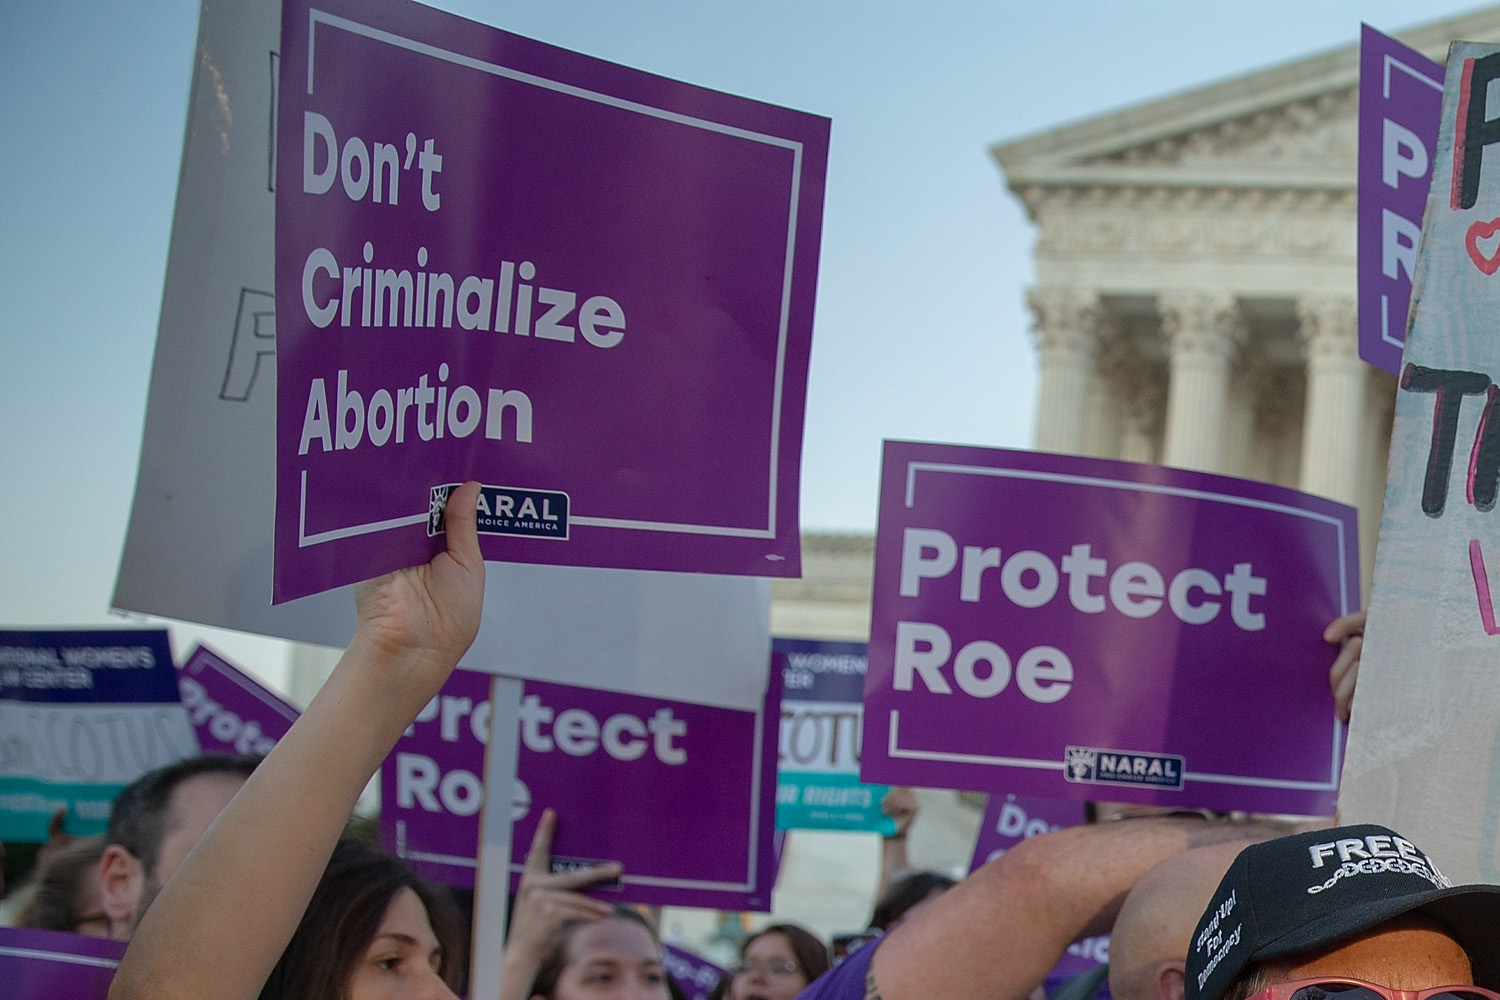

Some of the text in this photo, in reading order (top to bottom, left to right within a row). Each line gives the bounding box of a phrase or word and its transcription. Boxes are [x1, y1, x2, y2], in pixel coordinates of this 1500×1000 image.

[303, 111, 443, 212] Don’t
[302, 241, 627, 348] Criminalize
[298, 362, 533, 455] Abortion
[476, 493, 559, 521] ARAL
[899, 528, 1267, 632] Protect
[893, 621, 1074, 704] Roe
[1101, 754, 1178, 778] NARAL
[1308, 835, 1425, 869] FREE
